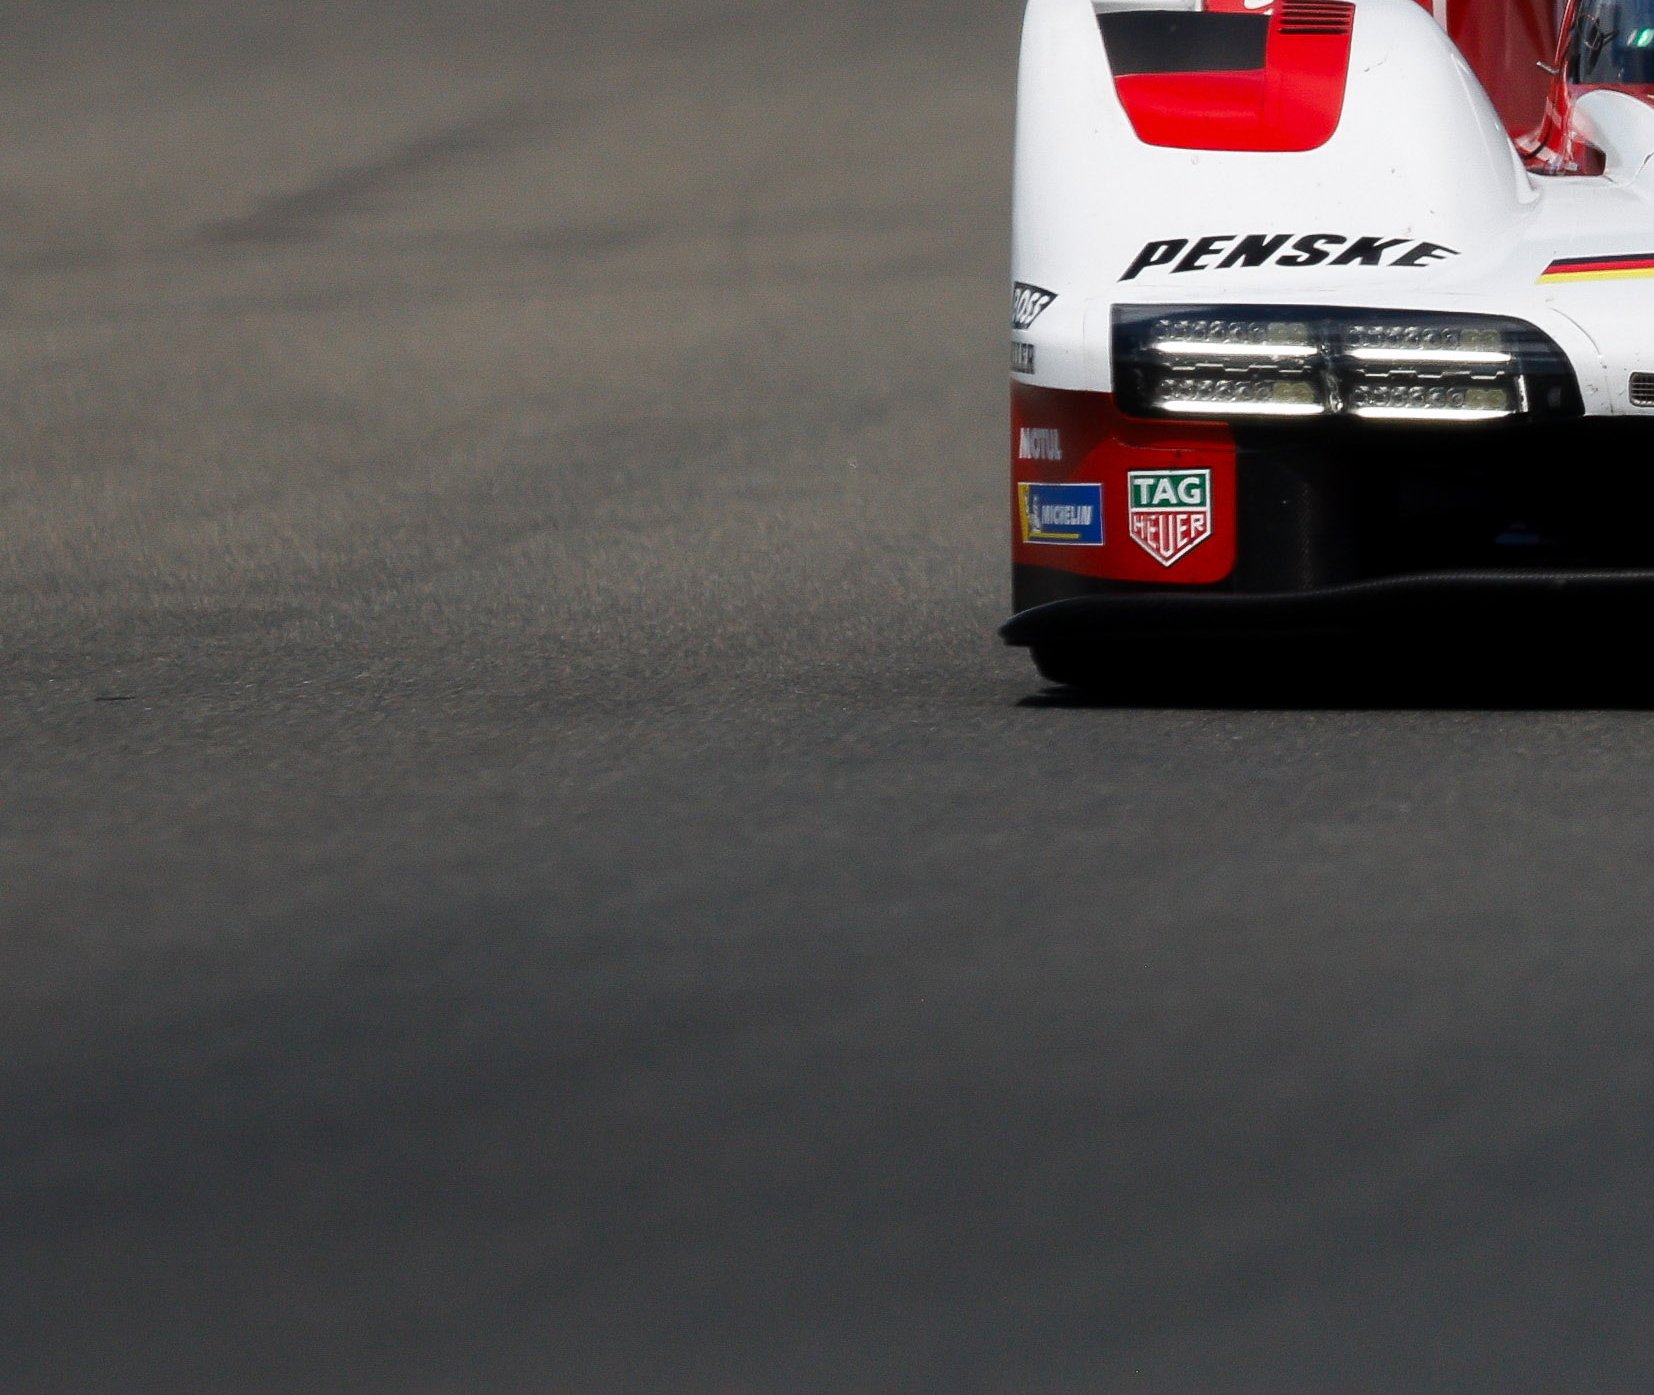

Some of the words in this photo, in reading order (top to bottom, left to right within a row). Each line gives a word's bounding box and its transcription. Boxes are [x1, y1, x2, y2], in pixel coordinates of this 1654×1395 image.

[1118, 232, 1462, 282] PENSKE
[1018, 427, 1063, 461] MOTUL
[1133, 476, 1201, 505] TAG
[1041, 505, 1094, 526] MICHELIN
[1132, 513, 1206, 558] HEUER
